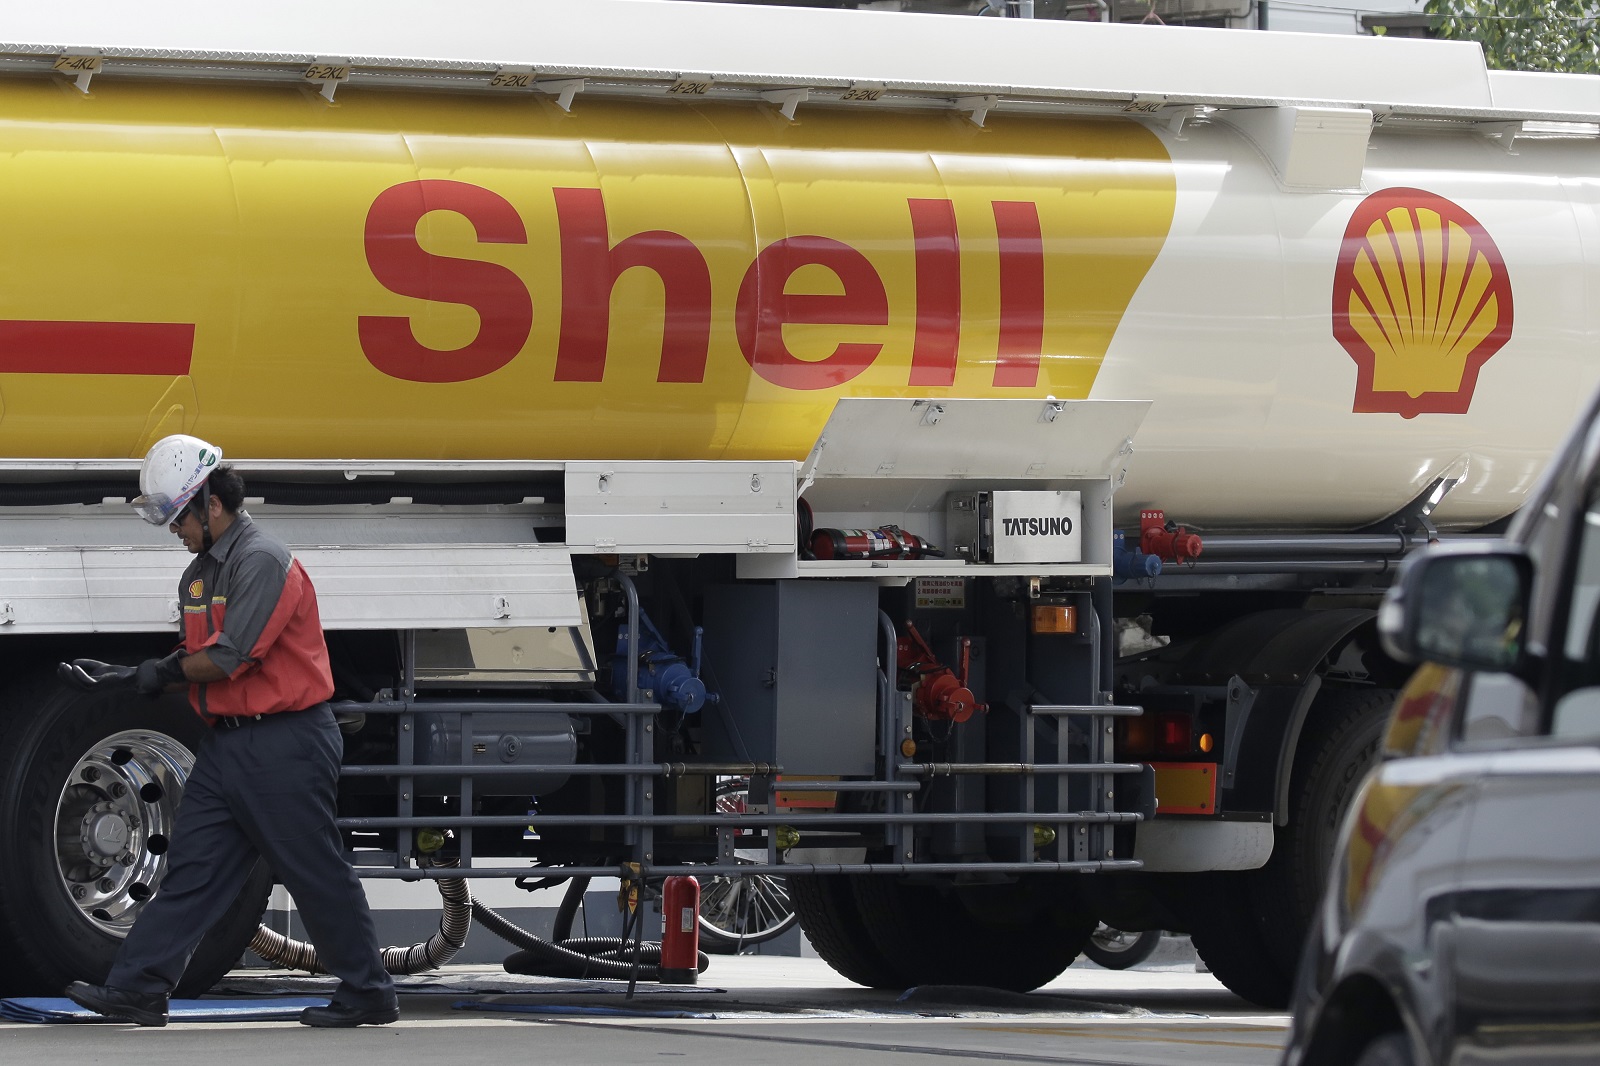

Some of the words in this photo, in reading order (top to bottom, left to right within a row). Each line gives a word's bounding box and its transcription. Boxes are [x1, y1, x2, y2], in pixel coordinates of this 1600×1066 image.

[53, 56, 95, 70] 7-4KL
[304, 66, 344, 79] 6-2KL
[490, 74, 528, 87] 5-2KL
[670, 81, 708, 94] 4-2KL
[843, 89, 881, 101] 3-2KL
[1124, 102, 1161, 113] 2-4KL
[357, 179, 1044, 390] Shell
[1002, 516, 1073, 536] TATSUNO
